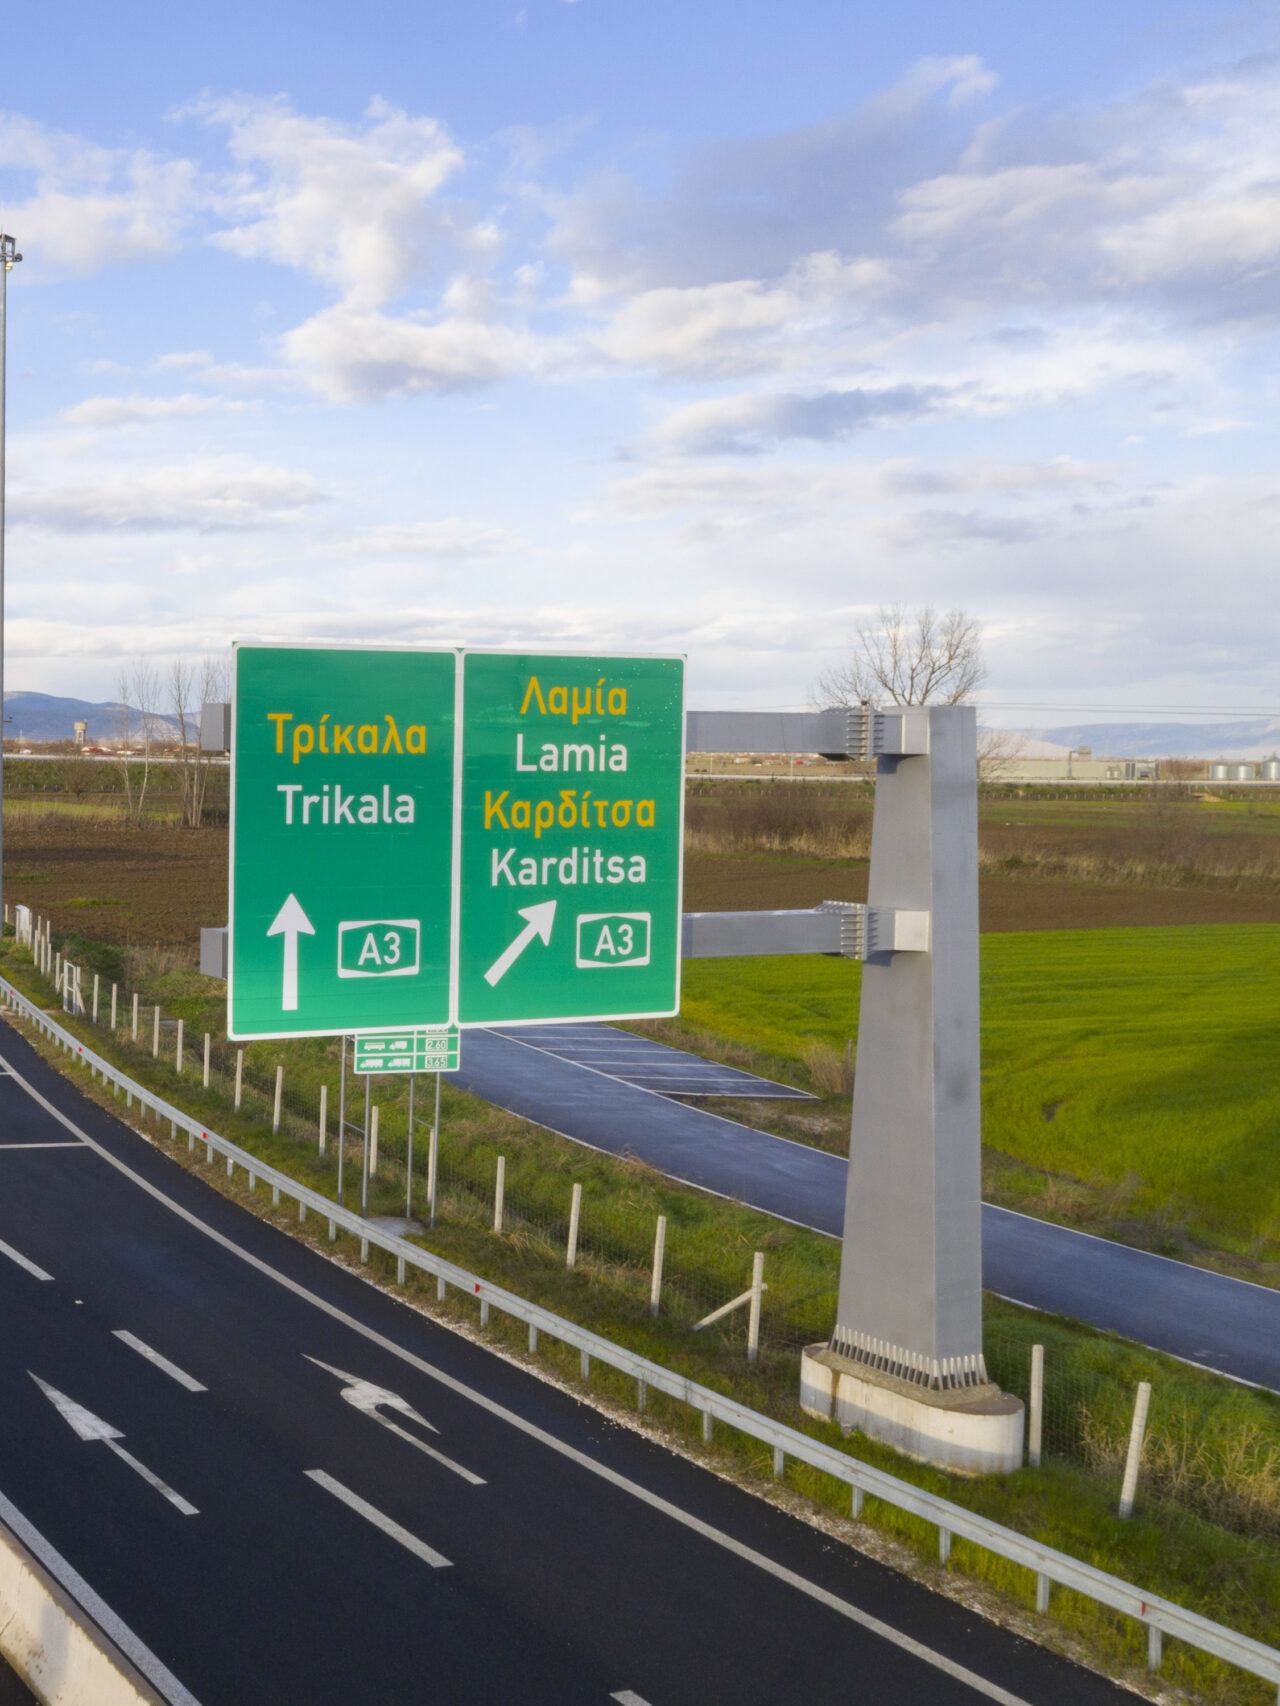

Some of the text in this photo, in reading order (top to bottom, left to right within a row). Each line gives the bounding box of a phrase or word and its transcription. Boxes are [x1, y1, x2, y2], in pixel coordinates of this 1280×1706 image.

[520, 677, 628, 724] Λαμία
[267, 713, 426, 764] Τρίκαλα
[516, 733, 628, 772] Lamia
[277, 785, 415, 824] Trikala
[484, 790, 656, 838] Καρδίτσα
[491, 847, 647, 887] Karditsa
[357, 932, 402, 966] A3
[594, 924, 634, 956] A3
